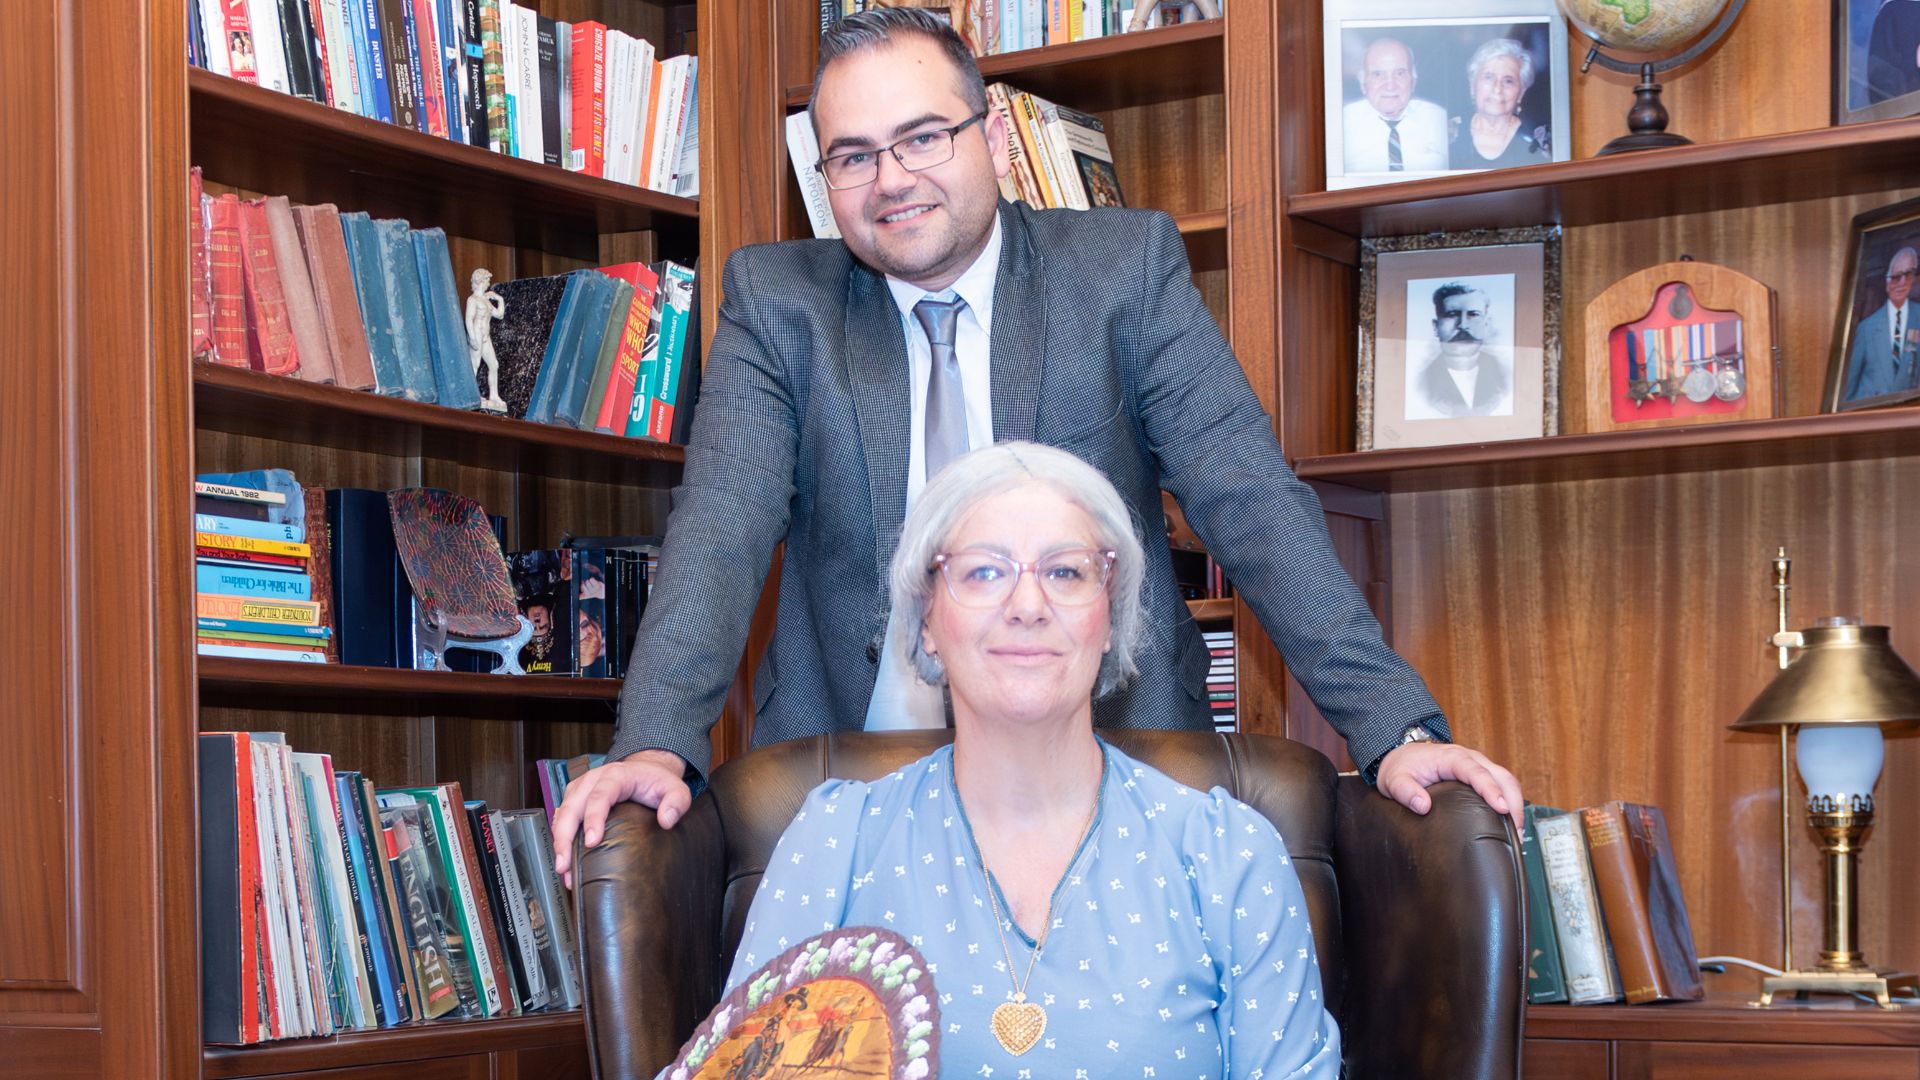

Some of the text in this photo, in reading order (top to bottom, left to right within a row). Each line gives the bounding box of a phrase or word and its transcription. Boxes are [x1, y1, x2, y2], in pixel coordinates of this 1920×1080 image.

[520, 16, 529, 47] JOHN
[372, 40, 382, 79] DUNSTER
[524, 58, 533, 90] CARRÉ
[472, 64, 482, 110] Hopscotch
[594, 28, 602, 158] CHIGOZIE OBIOMA THE FISHERMEN
[804, 166, 829, 228] NAPOLEON
[626, 326, 645, 354] WHO
[629, 313, 648, 338] WHO'S
[622, 352, 640, 375] SPORT
[660, 357, 672, 400] Crossword
[656, 406, 664, 434] OXFORD
[206, 486, 260, 498] ANNUAL 1982
[196, 548, 208, 556] You
[220, 550, 235, 558] Your
[221, 576, 304, 594] The Bible for Children
[242, 606, 281, 619] CHILDREN'S
[282, 608, 312, 622] YOUNGER
[531, 662, 552, 672] Henry
[338, 825, 359, 901] VALLEY OF THUNDER
[364, 844, 378, 888] PLANET
[480, 813, 514, 936] PLANET David Attenborough
[496, 822, 506, 850] DAVID
[503, 851, 524, 927] ATTENBOROUGH
[522, 934, 530, 950] LIFE
[402, 854, 445, 989] ENGLISH
[460, 878, 478, 928] MAGICAL
[473, 931, 490, 974] STORIES
